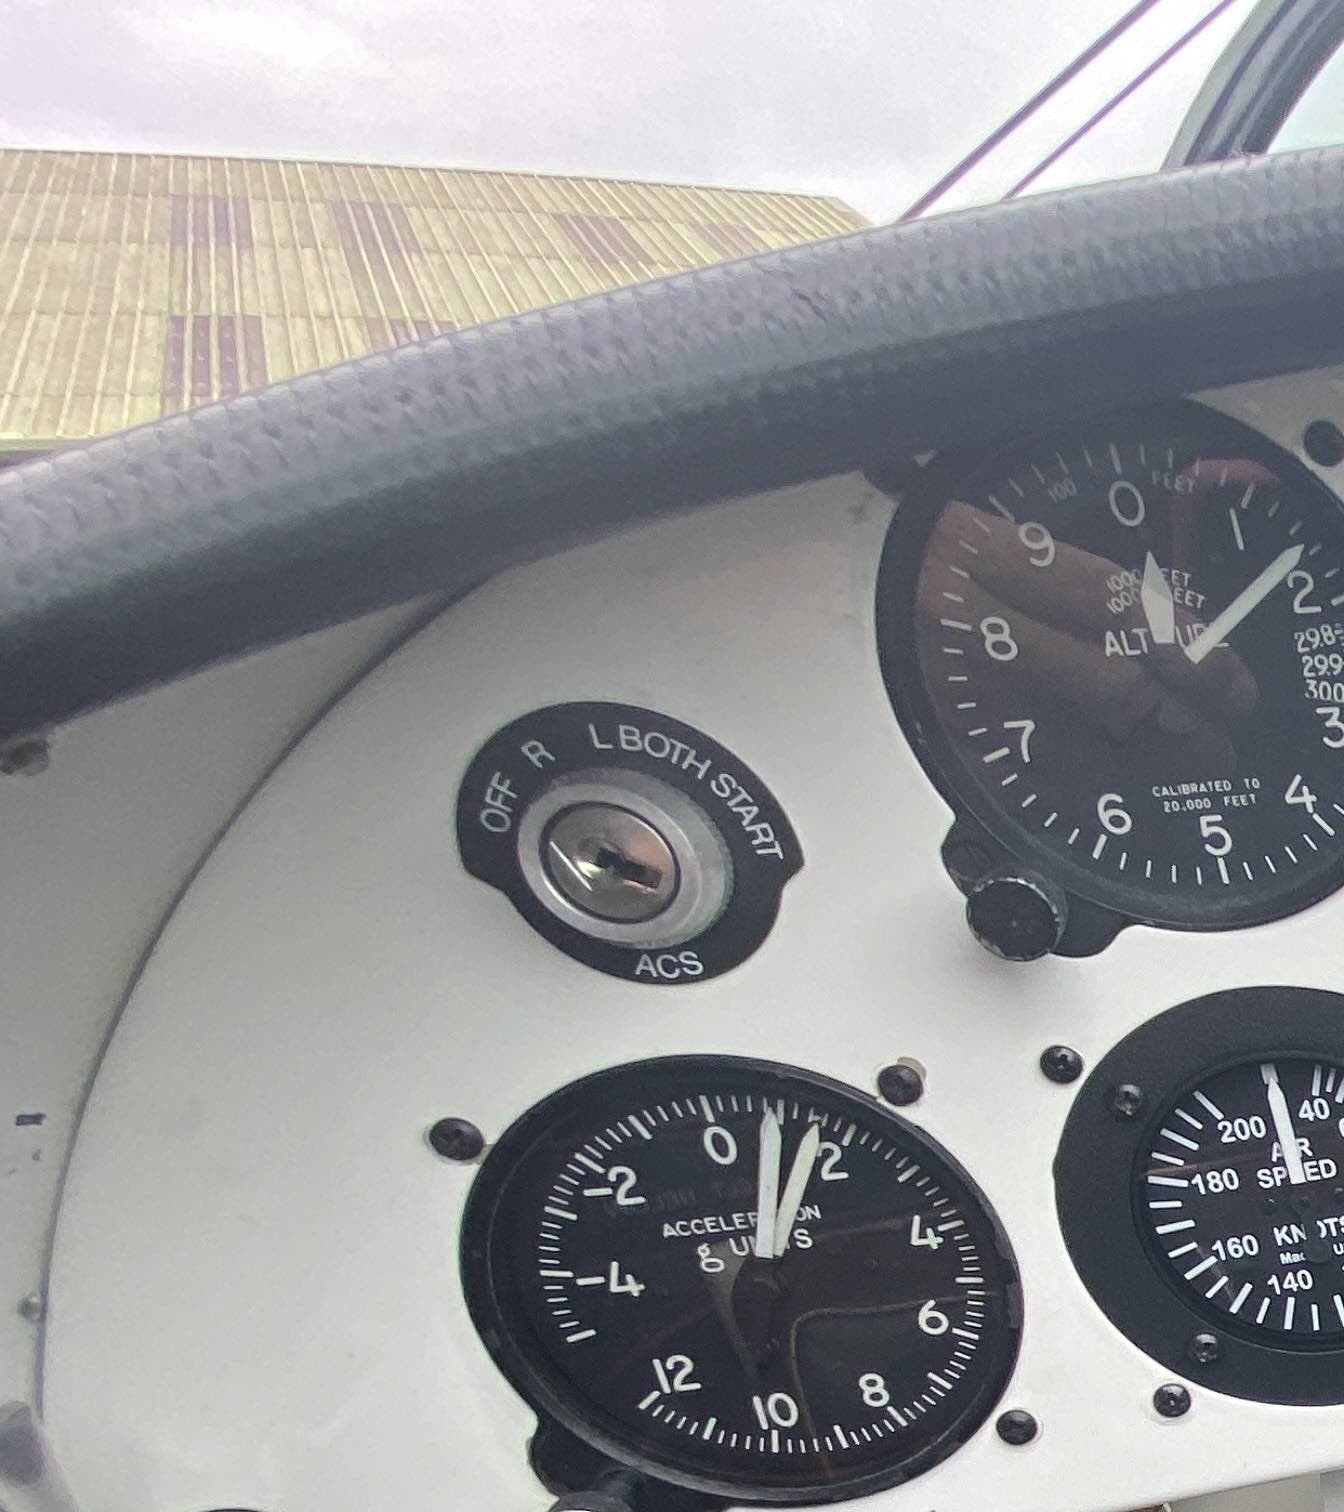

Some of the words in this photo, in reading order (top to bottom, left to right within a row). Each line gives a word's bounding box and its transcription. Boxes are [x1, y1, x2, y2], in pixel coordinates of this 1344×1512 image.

[1109, 481, 1145, 526] 0
[1019, 522, 1056, 567] 9
[1287, 569, 1322, 614] 2
[981, 617, 1019, 661] 8
[1003, 720, 1036, 764] 7
[481, 772, 516, 832] OFF
[521, 740, 555, 768] R
[589, 723, 612, 750] L
[619, 725, 712, 780] BOTH
[710, 774, 783, 862] START
[1152, 780, 1232, 797] CALIBRATED
[1244, 778, 1260, 789] TO
[1163, 798, 1212, 813] 20,000
[1224, 794, 1256, 807] FEET
[1284, 774, 1318, 814] 4
[1097, 794, 1134, 835] 6
[1200, 814, 1233, 857] 5
[635, 952, 704, 978] ACS
[1299, 1098, 1330, 1121] 40
[703, 1127, 738, 1165] 0
[1217, 1116, 1267, 1143] 200
[1191, 1168, 1239, 1195] 180
[910, 1214, 944, 1251] 4
[1211, 1234, 1259, 1260] 160
[1267, 1269, 1313, 1295] 140
[917, 1300, 950, 1336] 6
[653, 1356, 702, 1394] 12
[858, 1373, 890, 1408] 8
[753, 1394, 797, 1431] 10
